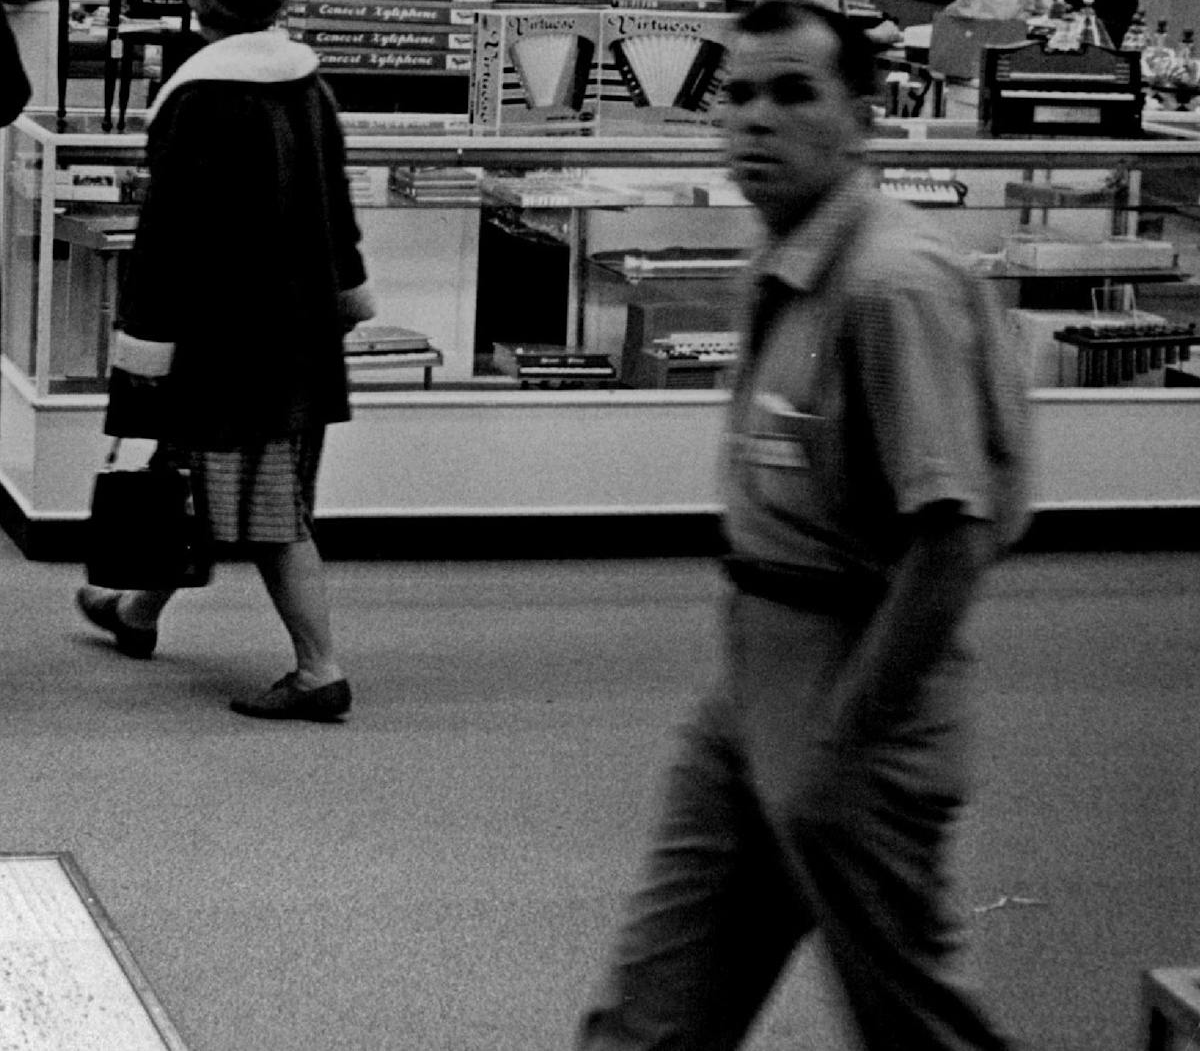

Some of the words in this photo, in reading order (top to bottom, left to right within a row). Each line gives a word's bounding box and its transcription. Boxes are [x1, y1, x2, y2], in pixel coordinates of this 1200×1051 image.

[318, 4, 366, 17] Concert
[374, 5, 438, 20] Xylophone
[508, 16, 576, 36] Virtuoso
[607, 15, 702, 35] Virtuoso
[316, 32, 364, 43] Concert
[371, 33, 436, 46] Xylophone
[368, 53, 433, 67] Xylophone
